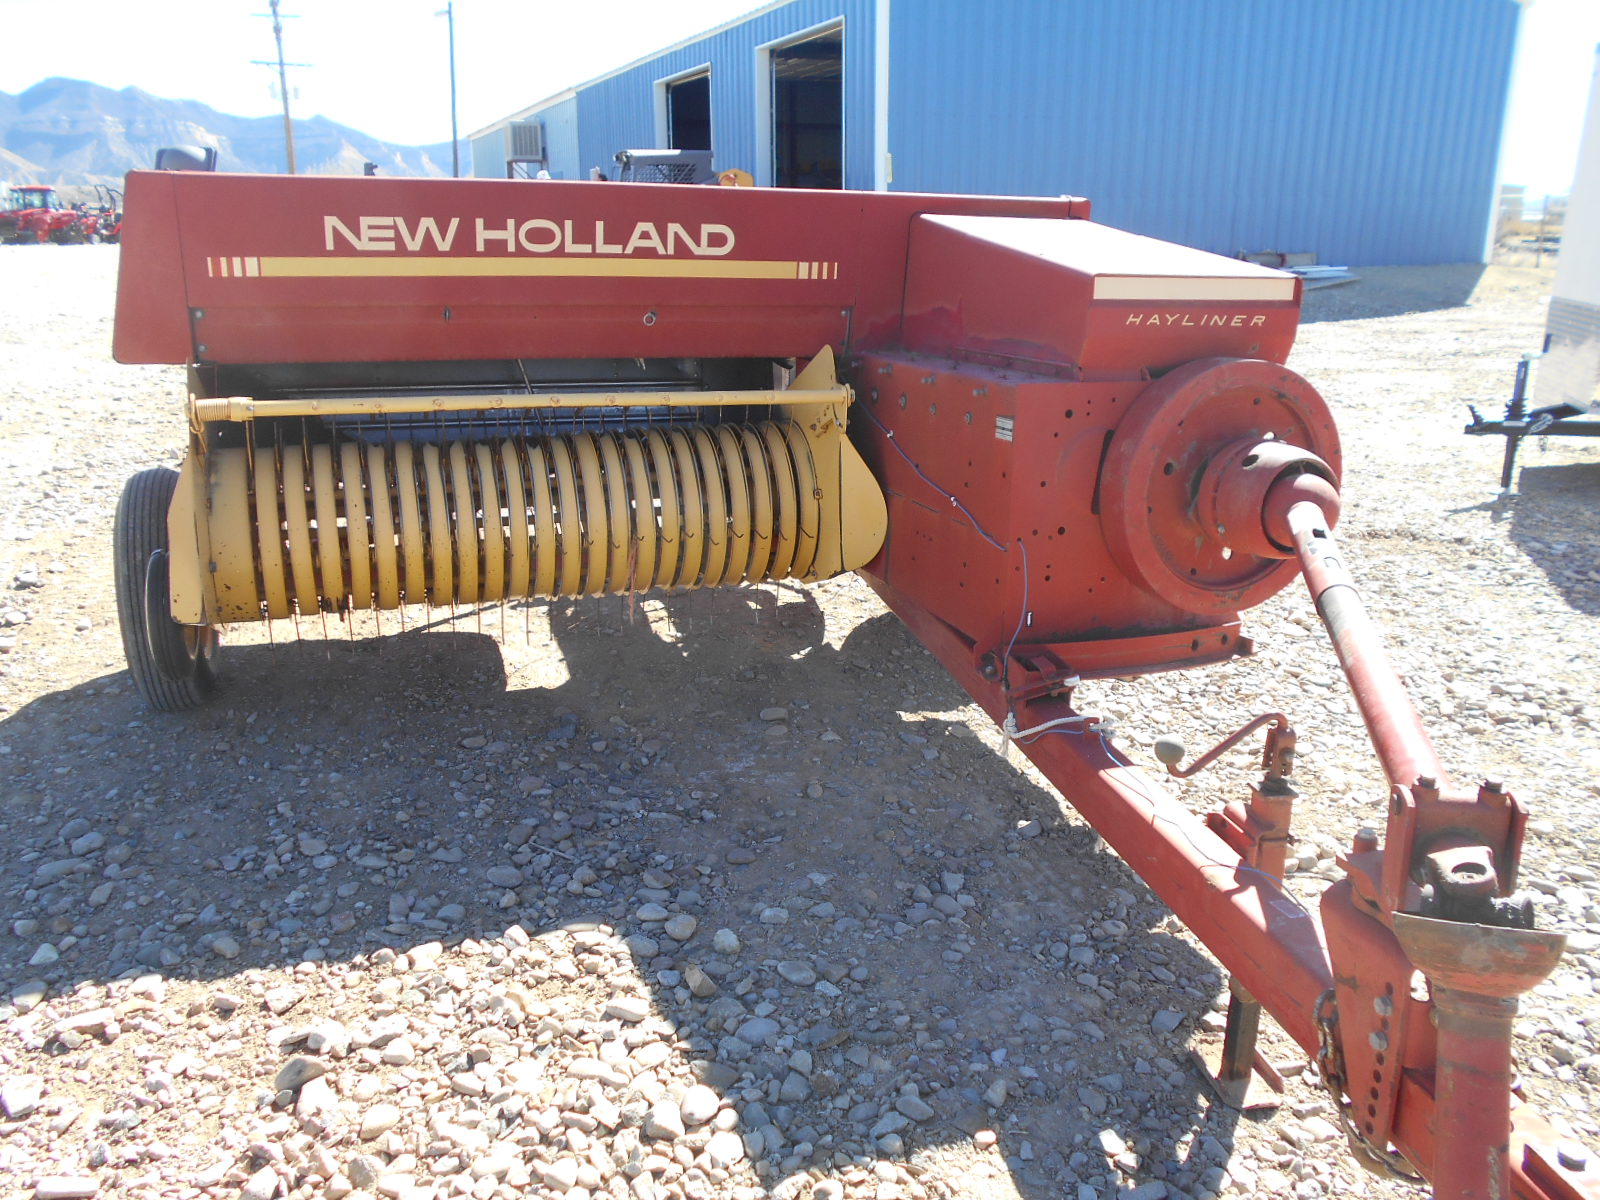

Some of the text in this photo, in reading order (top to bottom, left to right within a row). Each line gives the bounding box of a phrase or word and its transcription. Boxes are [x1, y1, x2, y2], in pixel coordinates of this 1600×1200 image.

[324, 216, 735, 255] NEW HOLLAND
[1126, 314, 1266, 326] HAYLINER
